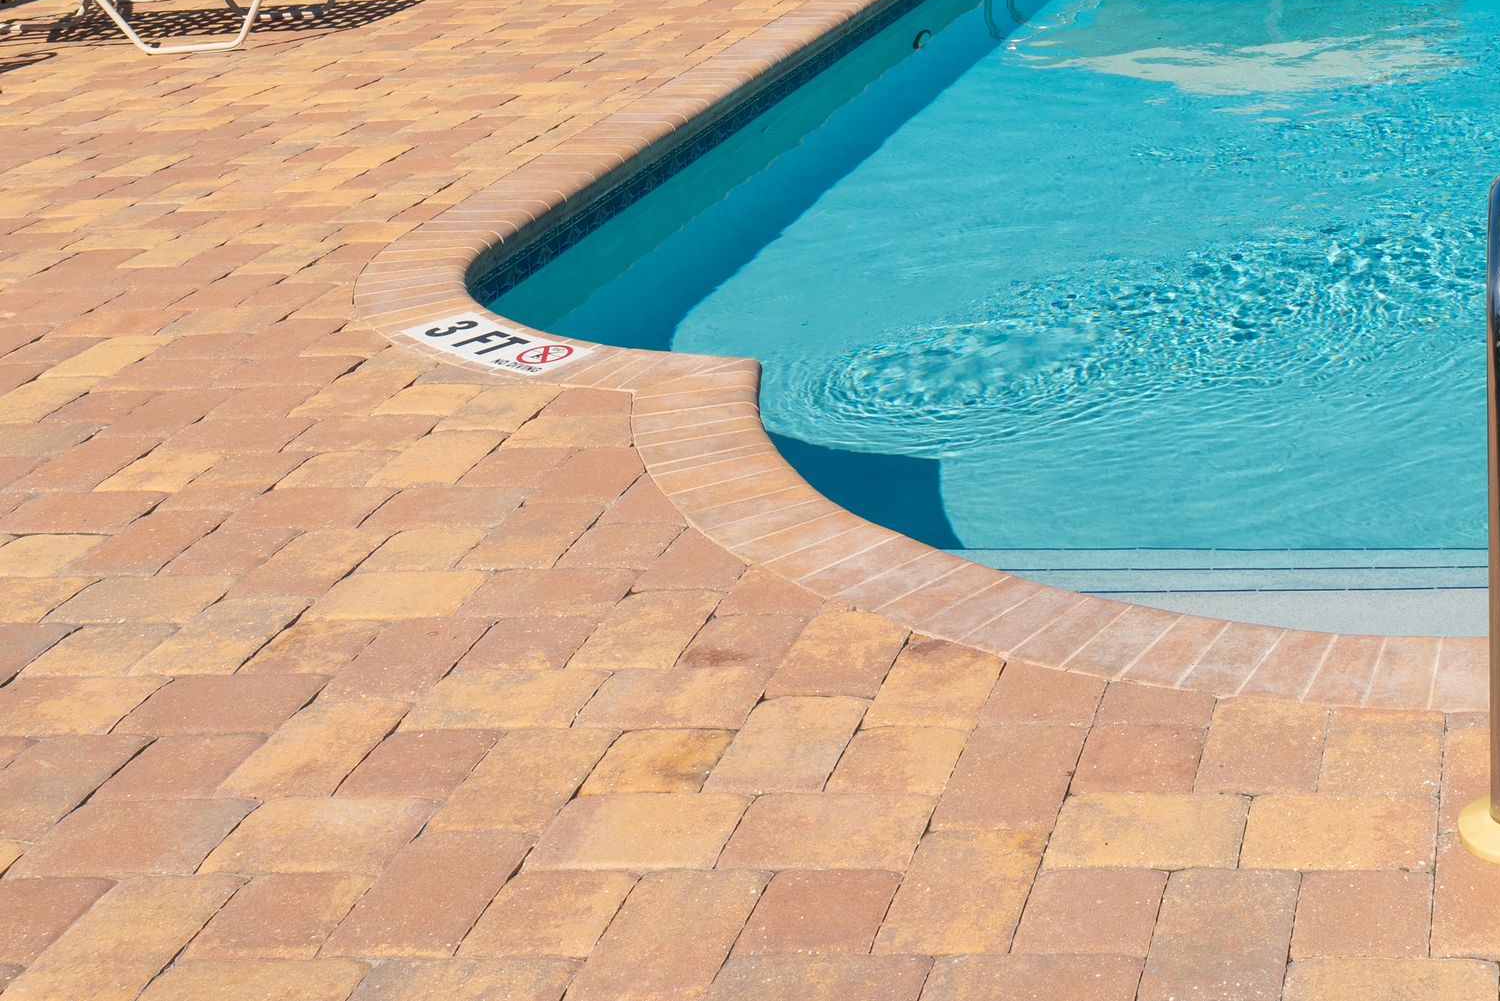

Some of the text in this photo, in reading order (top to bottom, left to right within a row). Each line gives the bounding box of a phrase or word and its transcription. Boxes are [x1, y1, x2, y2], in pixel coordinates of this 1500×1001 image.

[424, 320, 531, 356] 3 FT
[506, 362, 542, 373] DIVING
